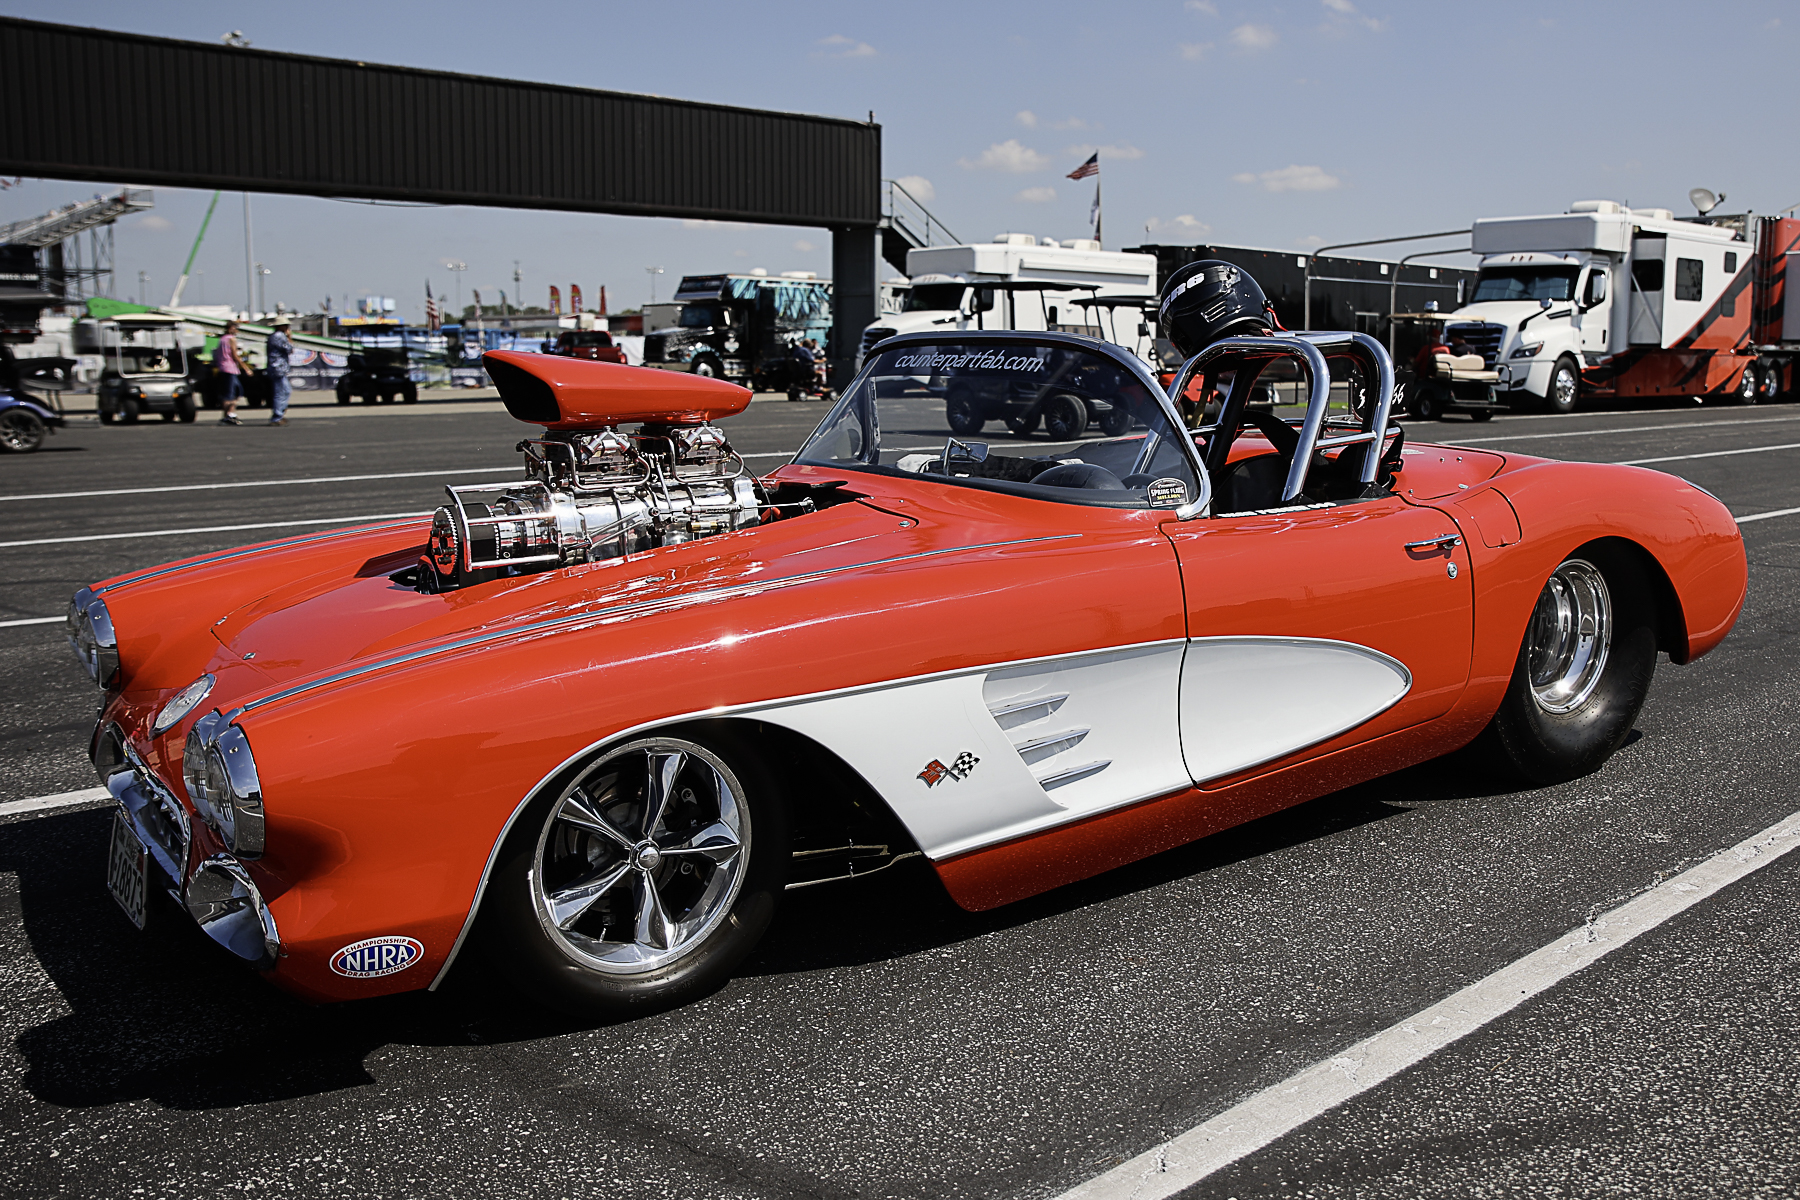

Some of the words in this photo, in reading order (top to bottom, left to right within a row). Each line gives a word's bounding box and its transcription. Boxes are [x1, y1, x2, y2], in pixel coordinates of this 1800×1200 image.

[894, 349, 1044, 373] counterpartfab.com
[1150, 488, 1170, 497] SPRING
[345, 938, 407, 955] CHAMPIONSHIP
[346, 945, 409, 971] NHRA
[346, 969, 371, 978] DRAG
[374, 963, 406, 977] RACING
